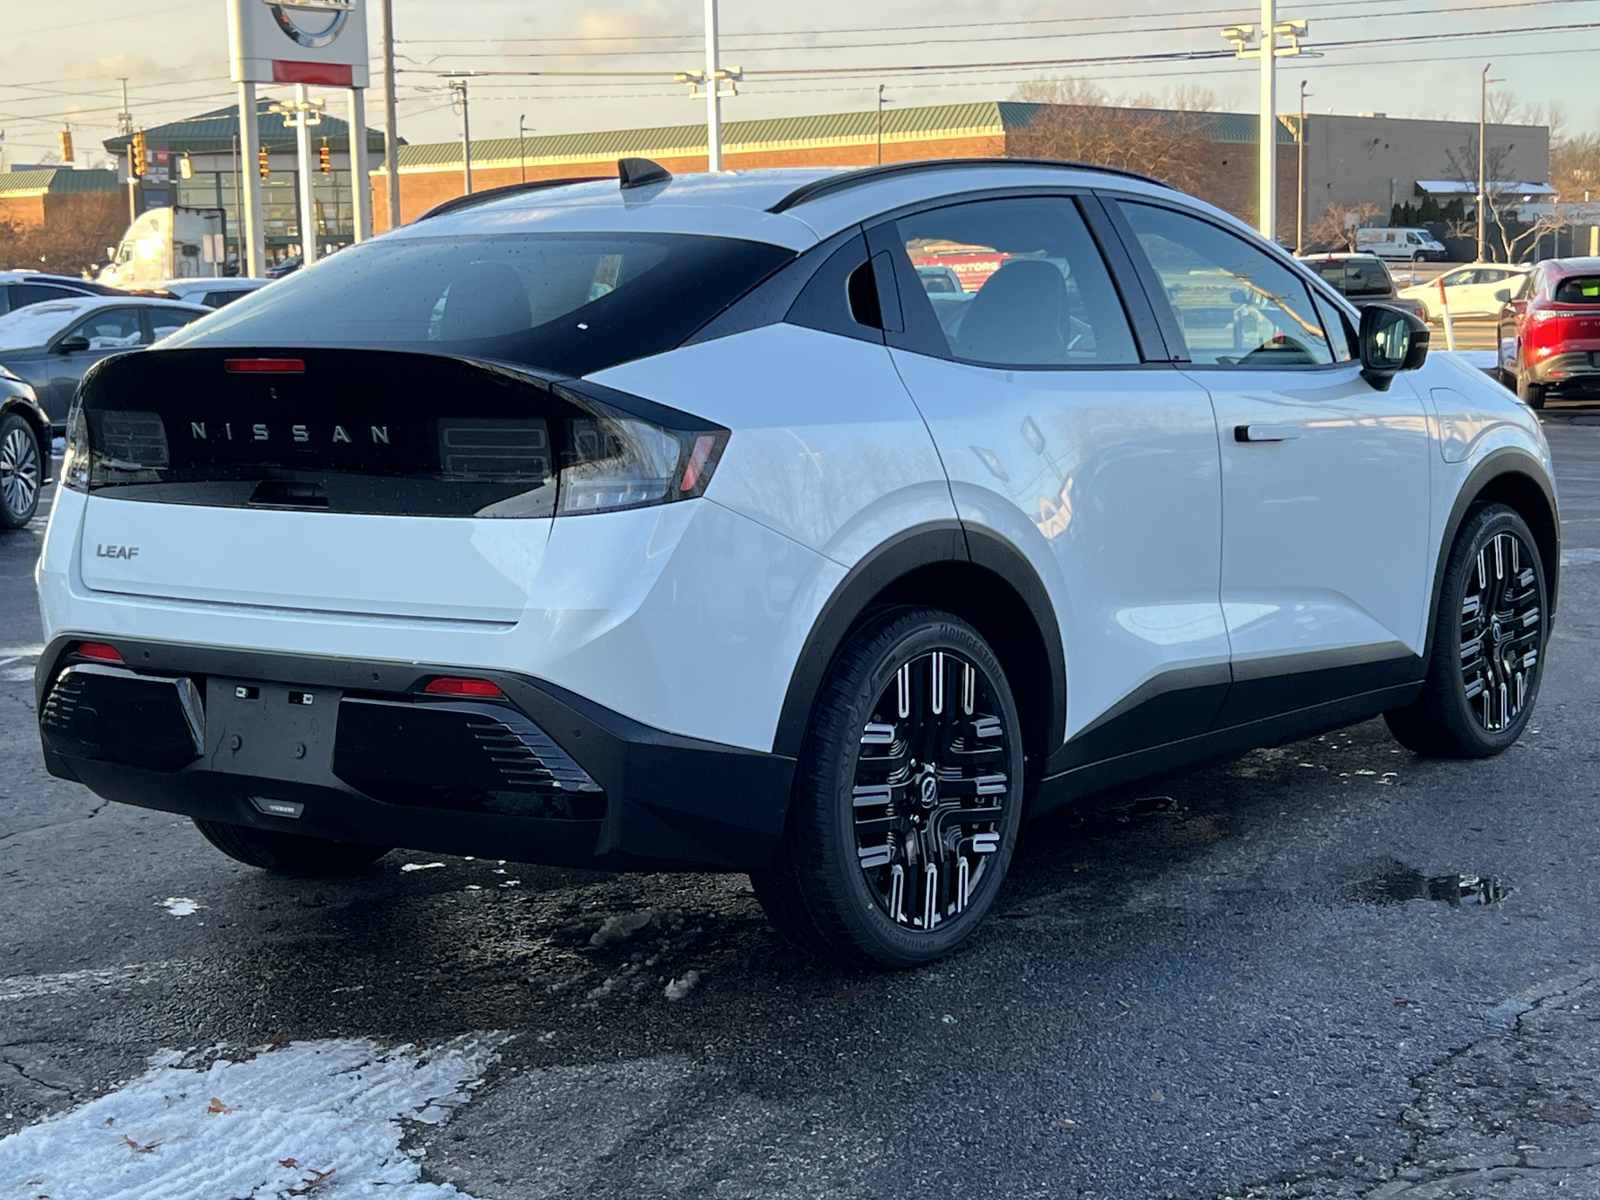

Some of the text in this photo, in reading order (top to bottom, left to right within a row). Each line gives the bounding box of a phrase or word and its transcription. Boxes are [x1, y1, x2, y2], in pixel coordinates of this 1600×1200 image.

[949, 261, 999, 272] ACTORS
[190, 421, 390, 444] NISSAN
[96, 544, 140, 560] LEAF
[939, 624, 1005, 683] BRIDGESTONE
